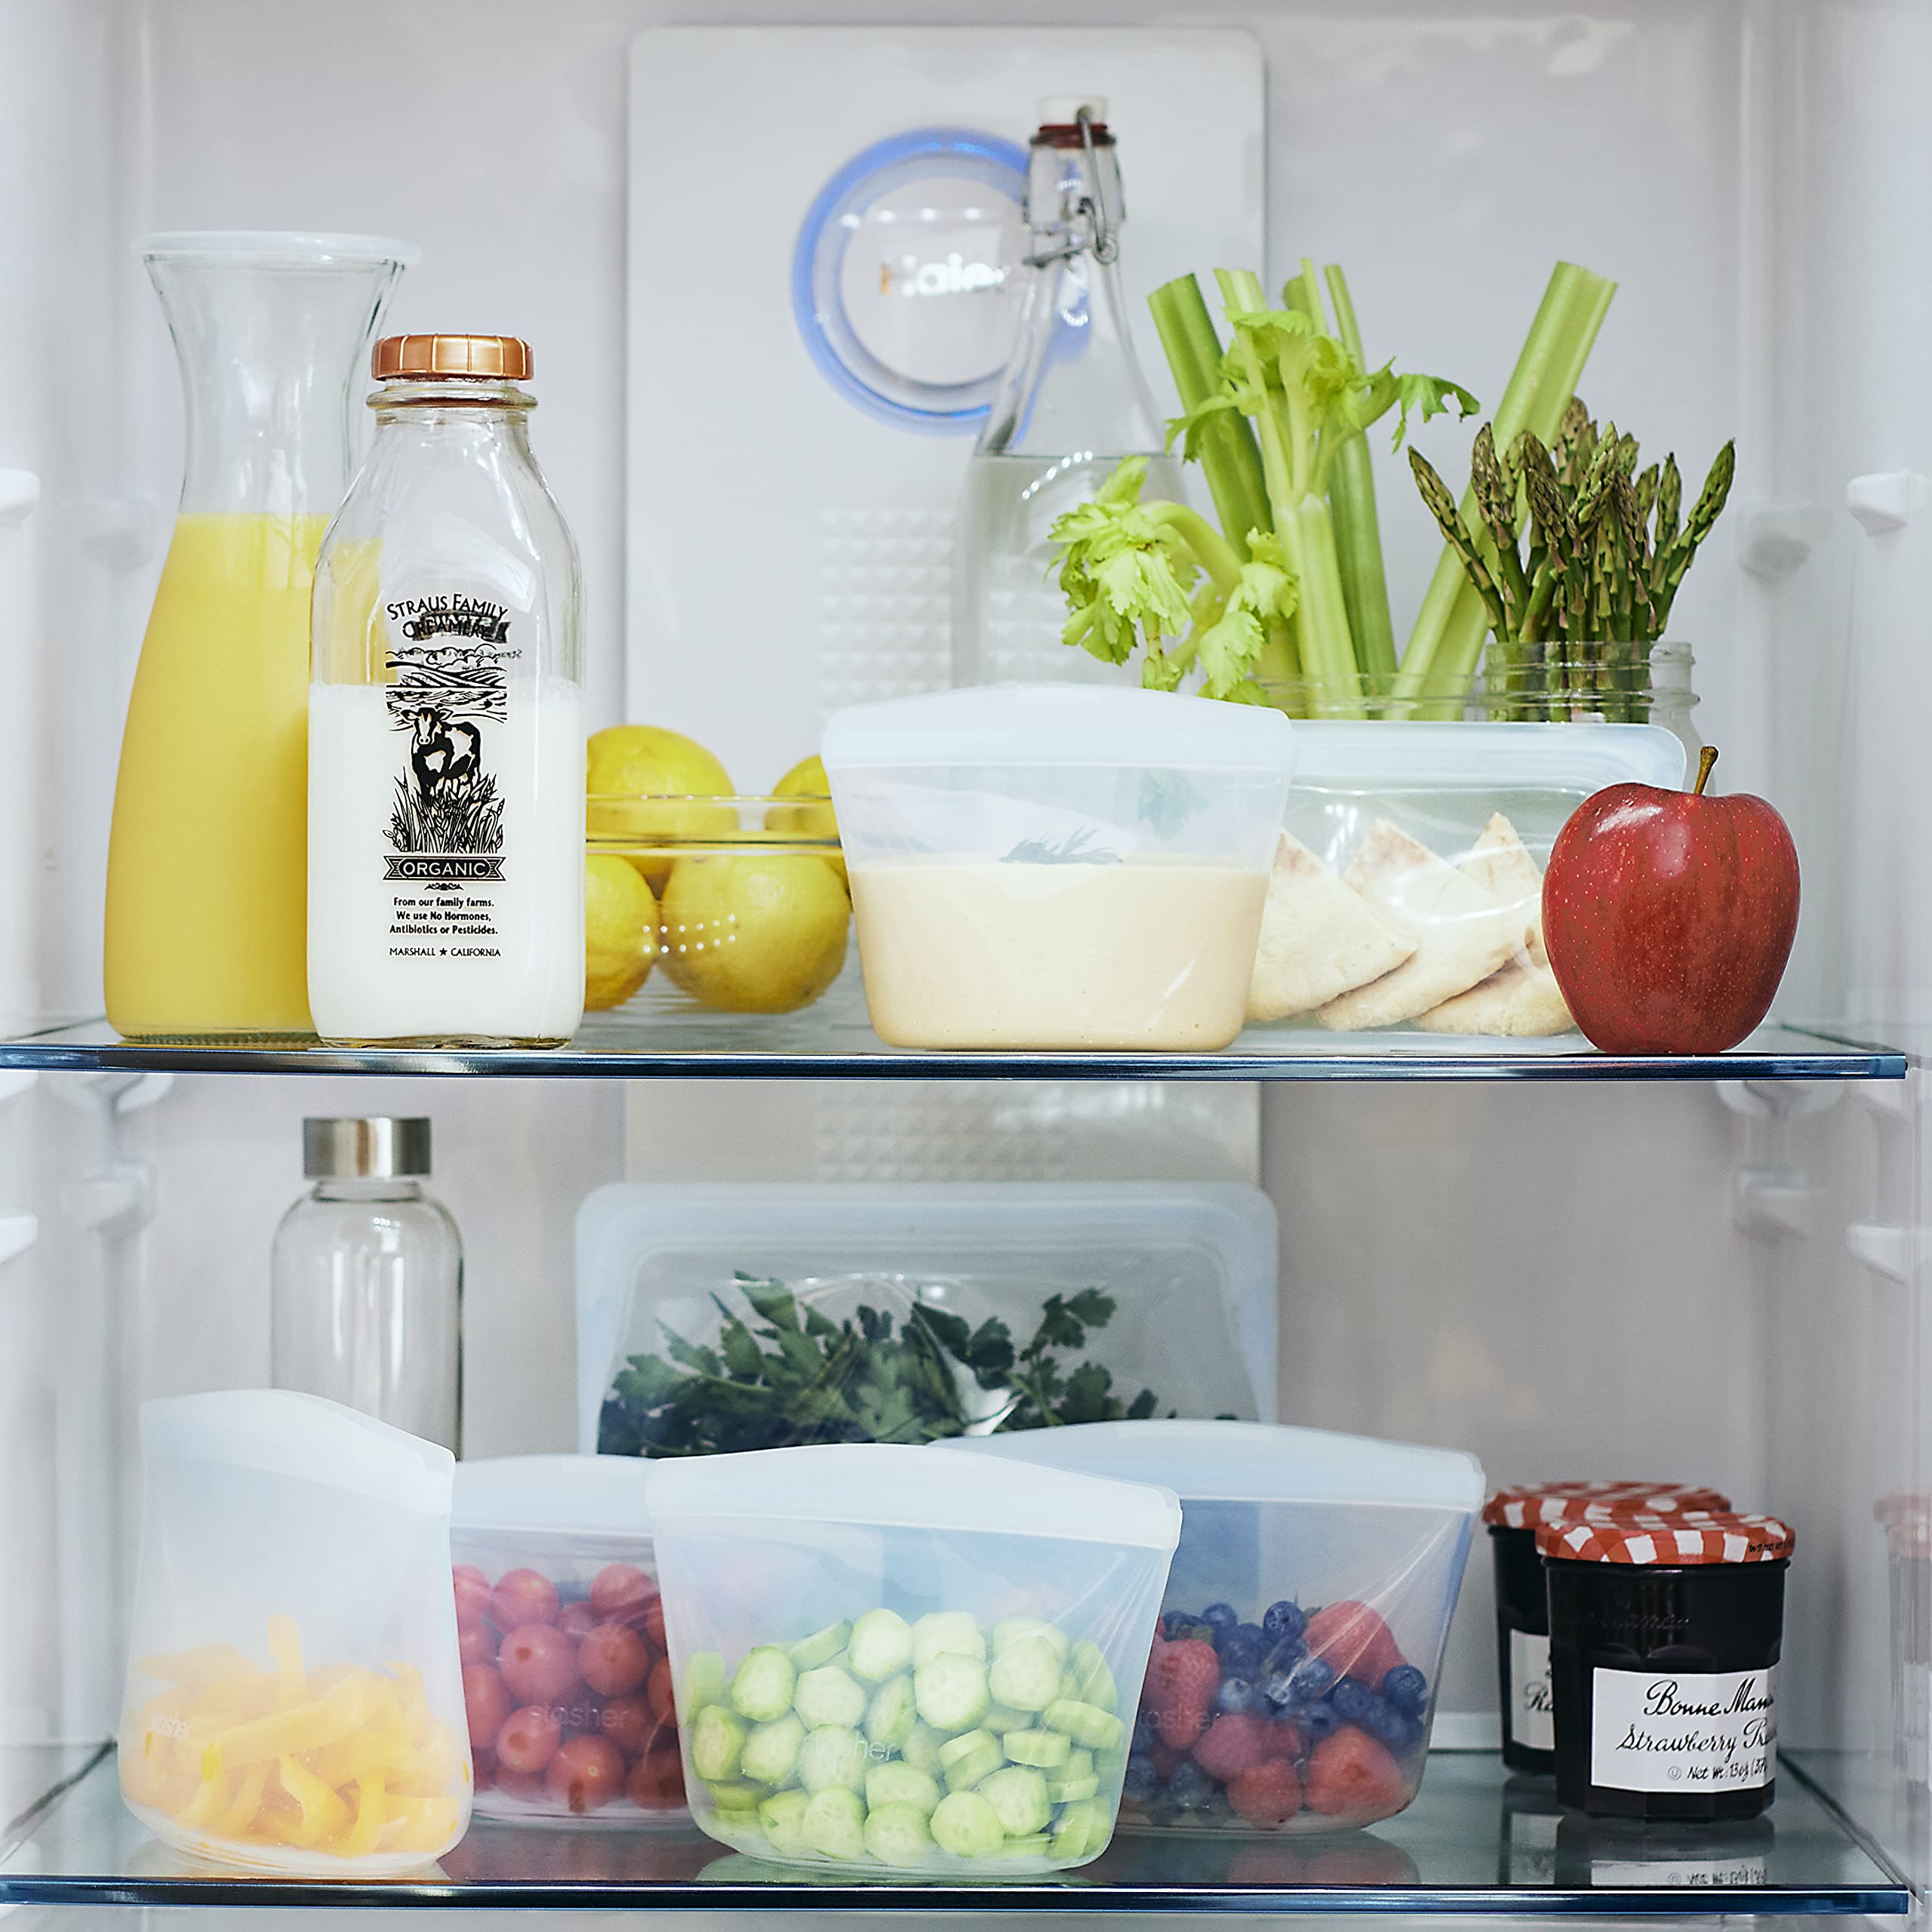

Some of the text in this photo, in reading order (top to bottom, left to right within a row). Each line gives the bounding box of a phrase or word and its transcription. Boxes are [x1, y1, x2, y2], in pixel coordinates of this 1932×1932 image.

[386, 595, 448, 621] STRAUS
[454, 592, 509, 620] FAMILY
[403, 617, 490, 638] CREAMERY
[403, 862, 486, 875] ORGANIC
[393, 897, 416, 906] From
[436, 897, 464, 909] family
[466, 897, 494, 907] farms.
[396, 911, 411, 920] We
[430, 911, 441, 921] No
[445, 911, 491, 921] Hormones,
[389, 924, 438, 934] Antibiotics
[452, 925, 498, 935] Pesticides.
[389, 948, 501, 957] MARSHALL CALIFORNIA
[1644, 1679, 1721, 1716] Bonne
[1616, 1723, 1737, 1763] Strawberry
[1687, 1765, 1709, 1780] Net
